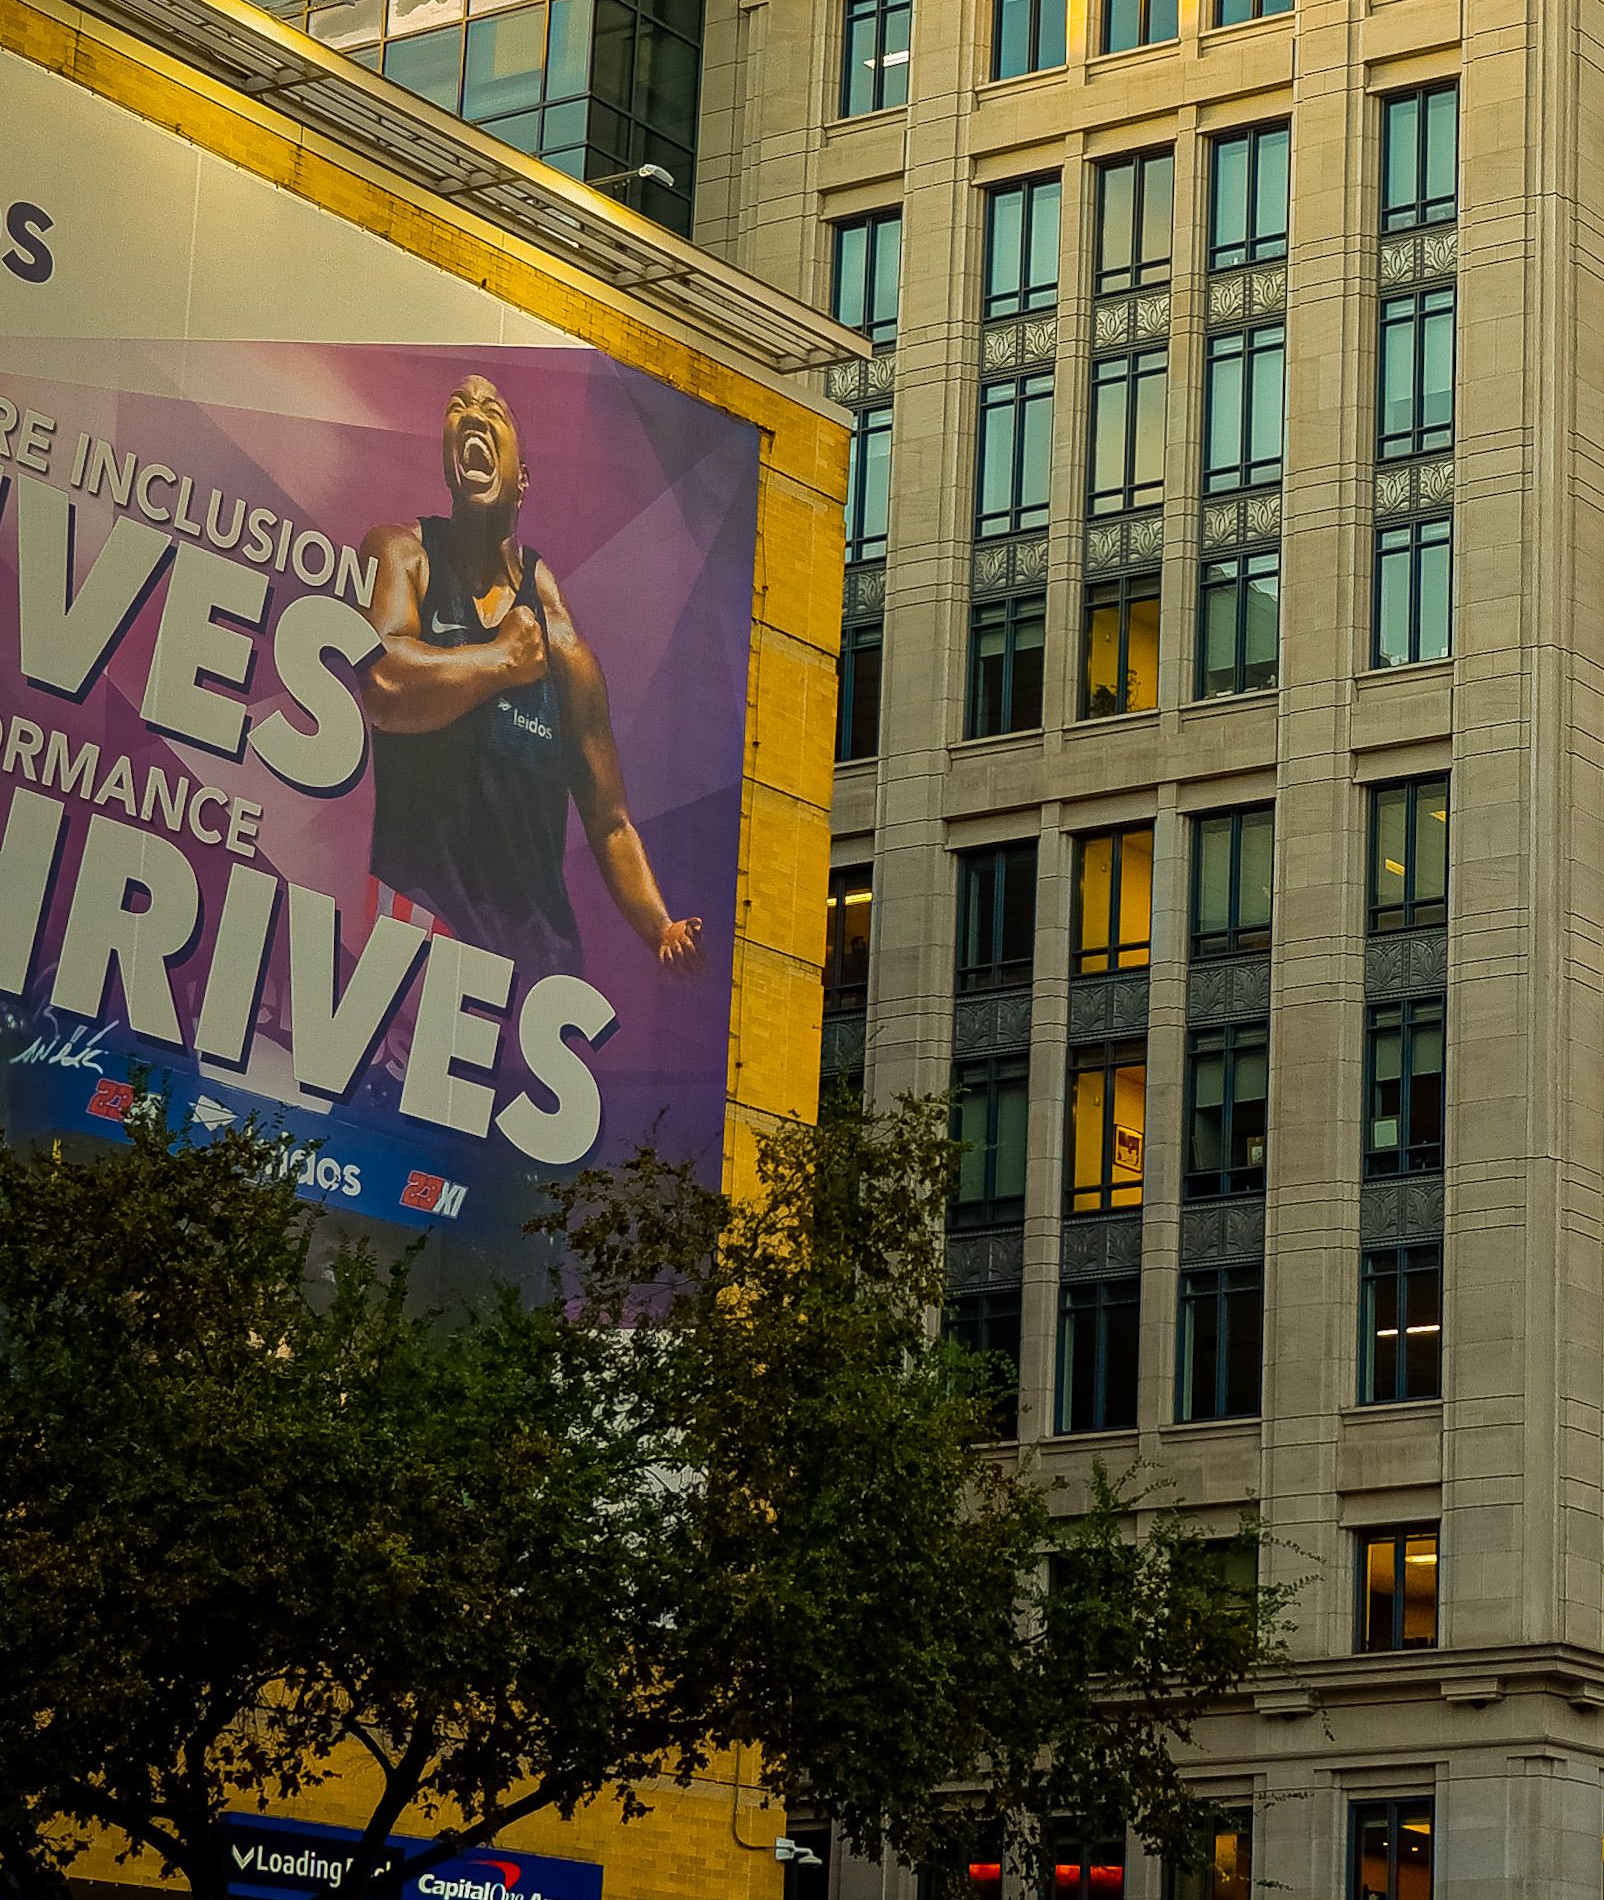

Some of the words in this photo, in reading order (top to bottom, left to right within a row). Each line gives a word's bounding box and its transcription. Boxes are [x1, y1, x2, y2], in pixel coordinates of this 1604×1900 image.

[70, 432, 379, 608] INCLUSION
[0, 463, 384, 790] VES
[0, 713, 263, 859] RMANCE
[513, 707, 553, 740] leidos
[256, 1845, 342, 1888] Loading
